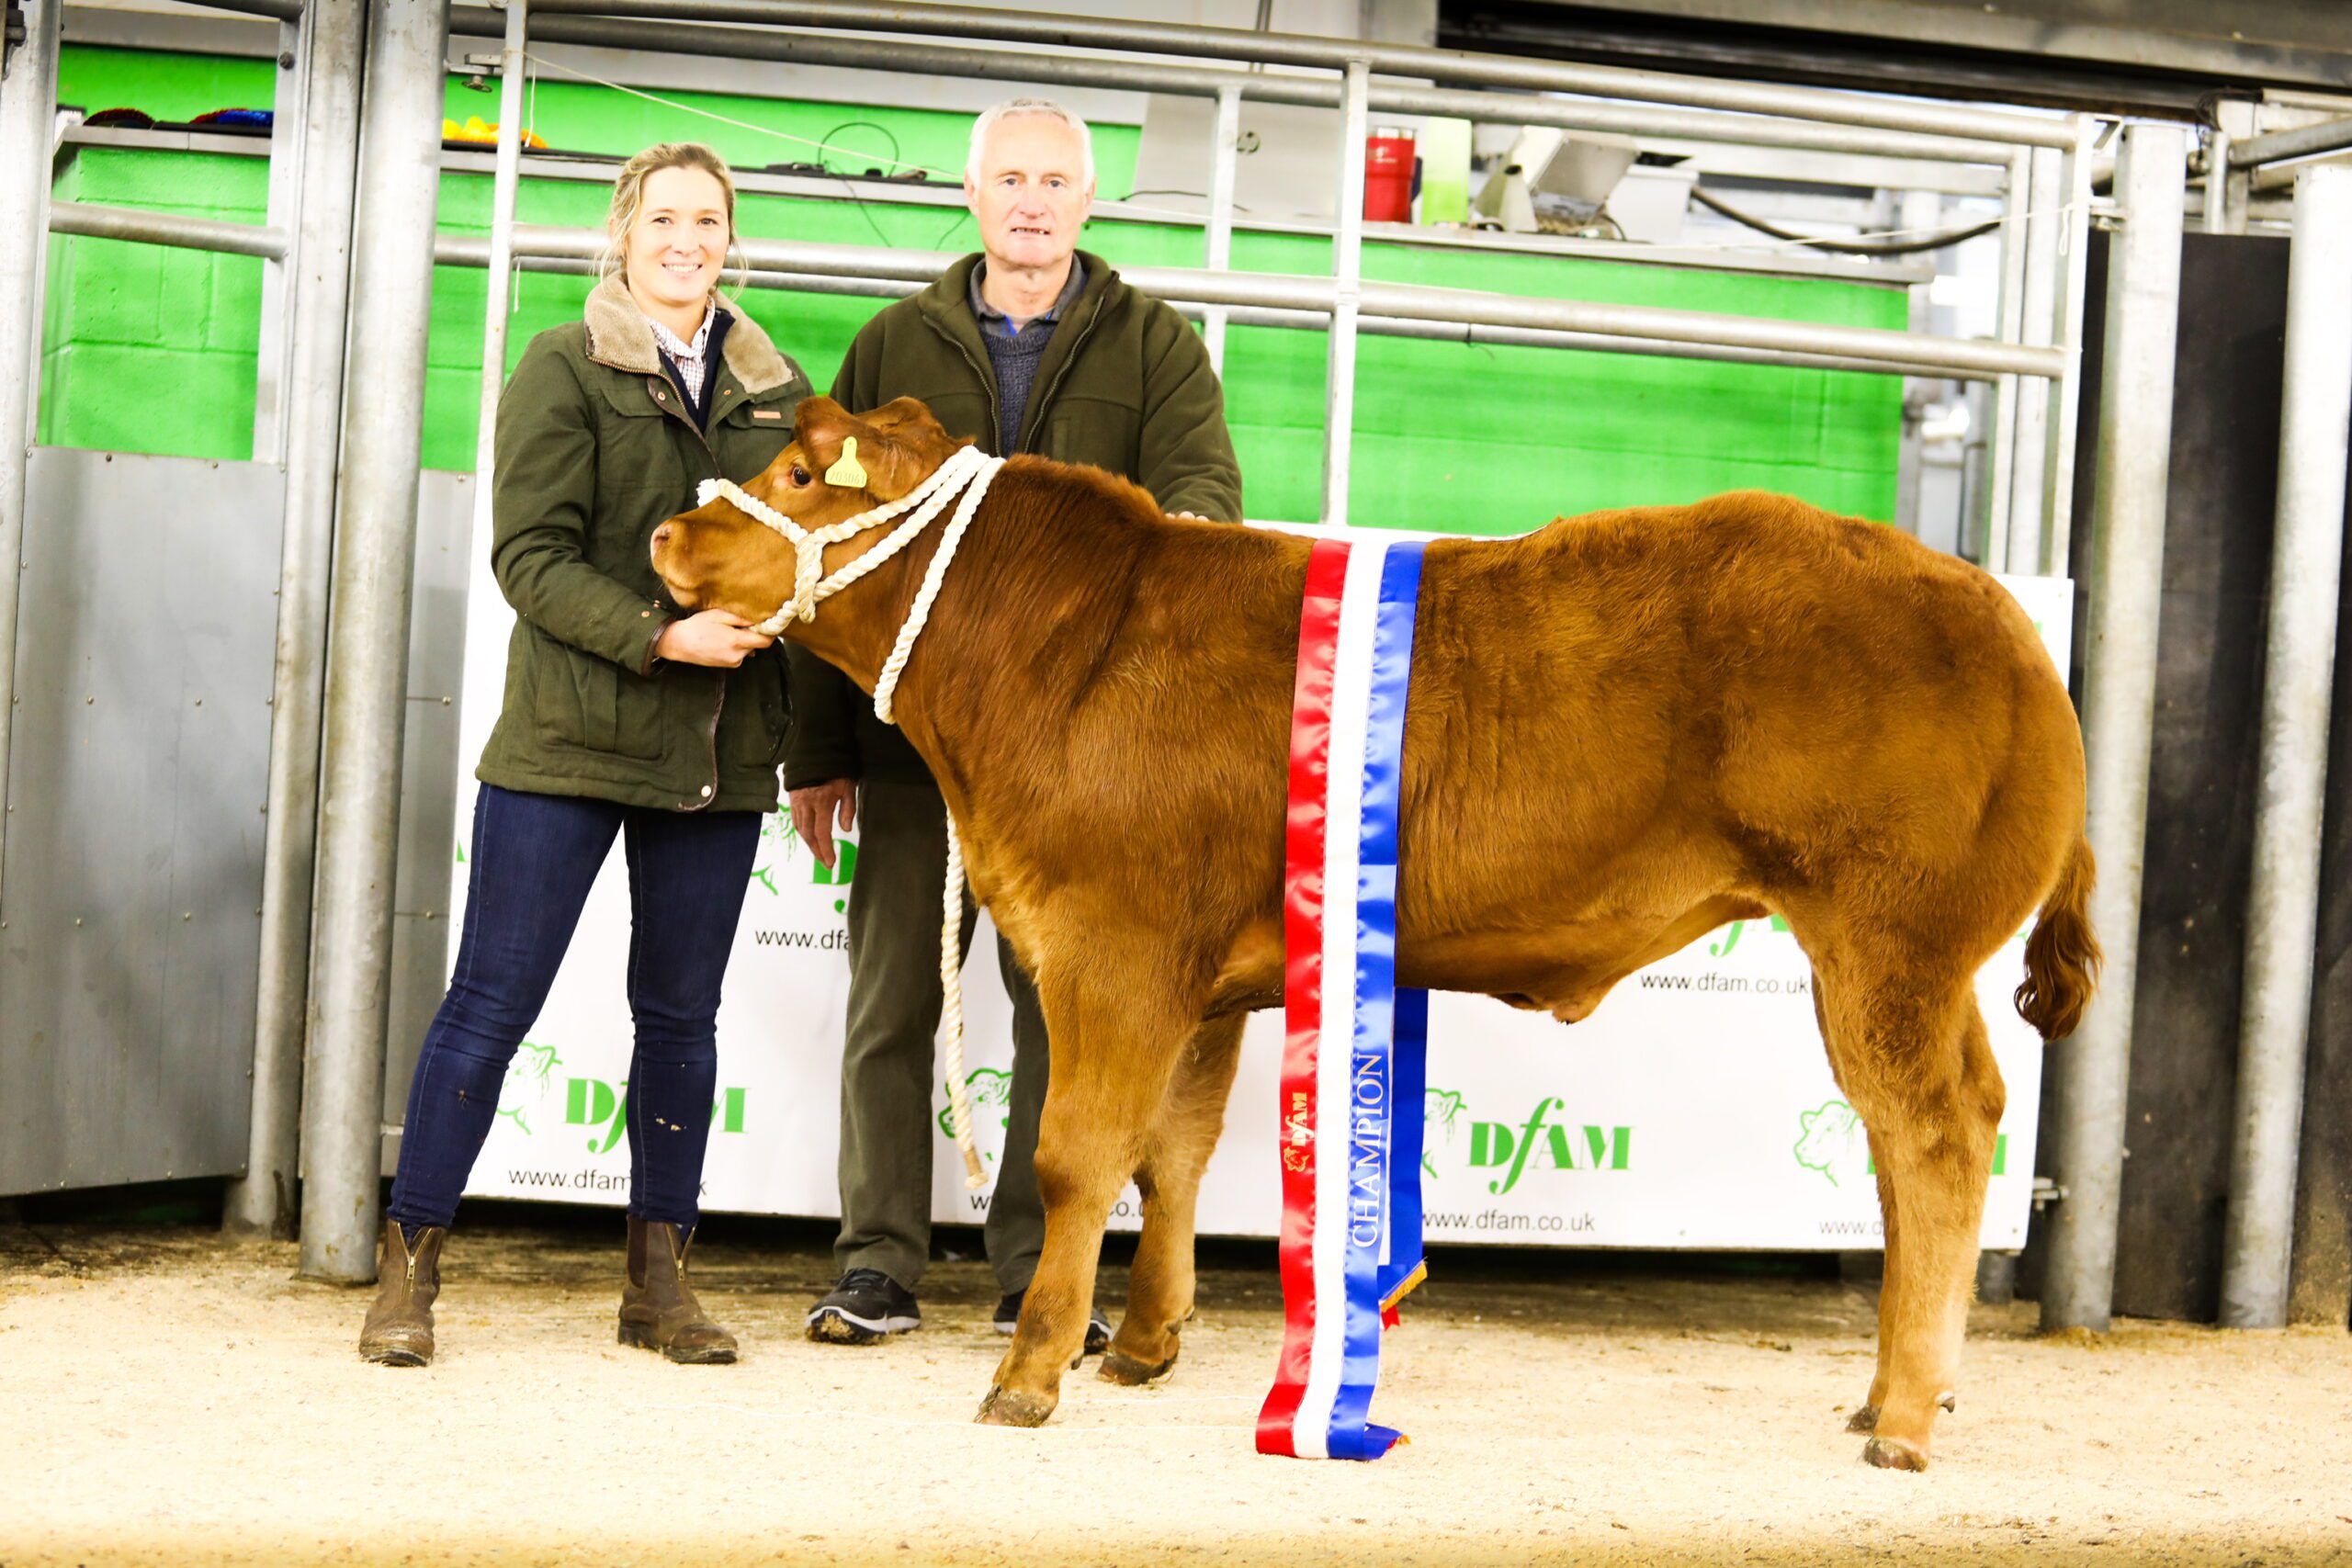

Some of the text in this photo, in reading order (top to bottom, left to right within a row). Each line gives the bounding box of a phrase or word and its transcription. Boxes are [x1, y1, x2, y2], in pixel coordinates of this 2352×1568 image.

[1640, 971, 1808, 995] www.dfam.co.uk
[1351, 1052, 1384, 1248] CHAMPION
[1466, 1096, 1635, 1195] DfAM
